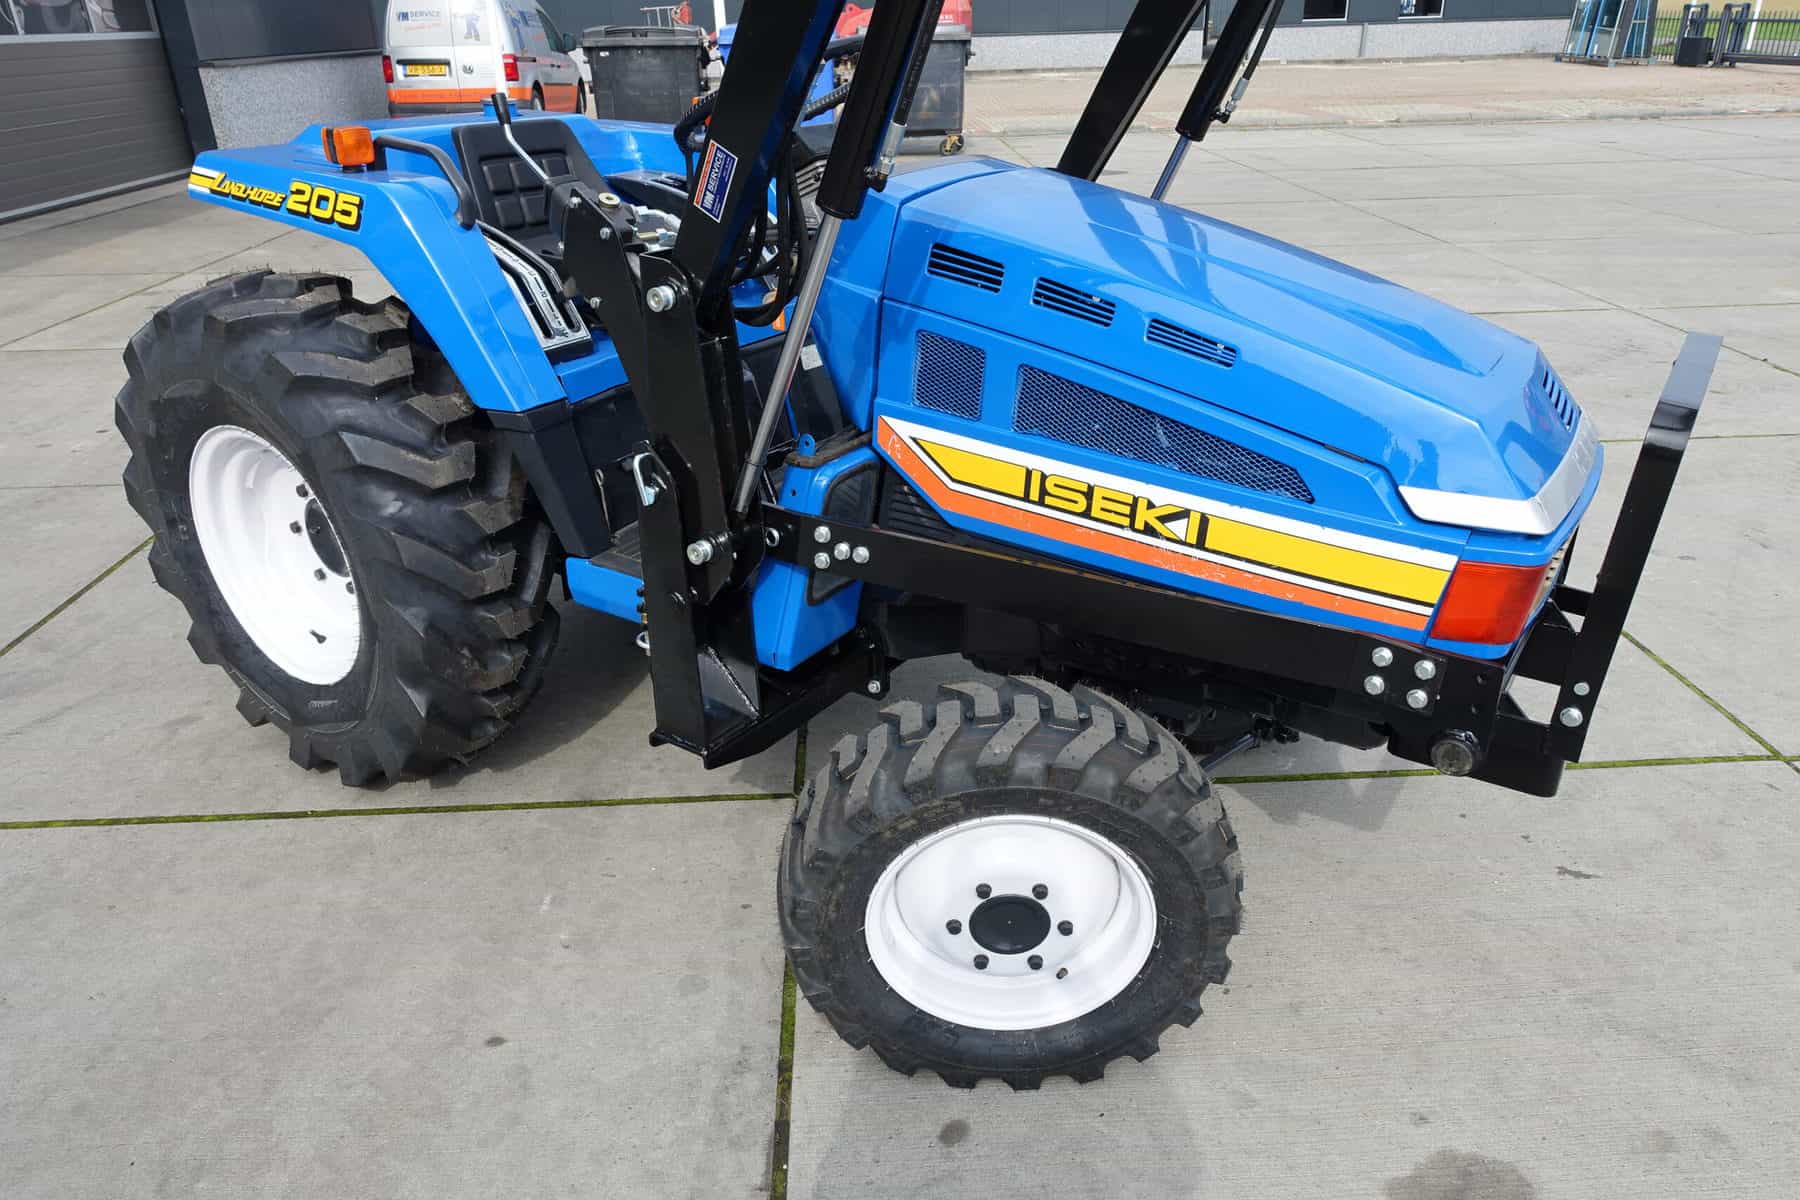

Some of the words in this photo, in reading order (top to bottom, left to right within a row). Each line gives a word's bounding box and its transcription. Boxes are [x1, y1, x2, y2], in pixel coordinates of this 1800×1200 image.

[707, 149, 726, 192] SERVICE
[286, 180, 362, 229] 205
[1029, 468, 1201, 546] ISEKI
